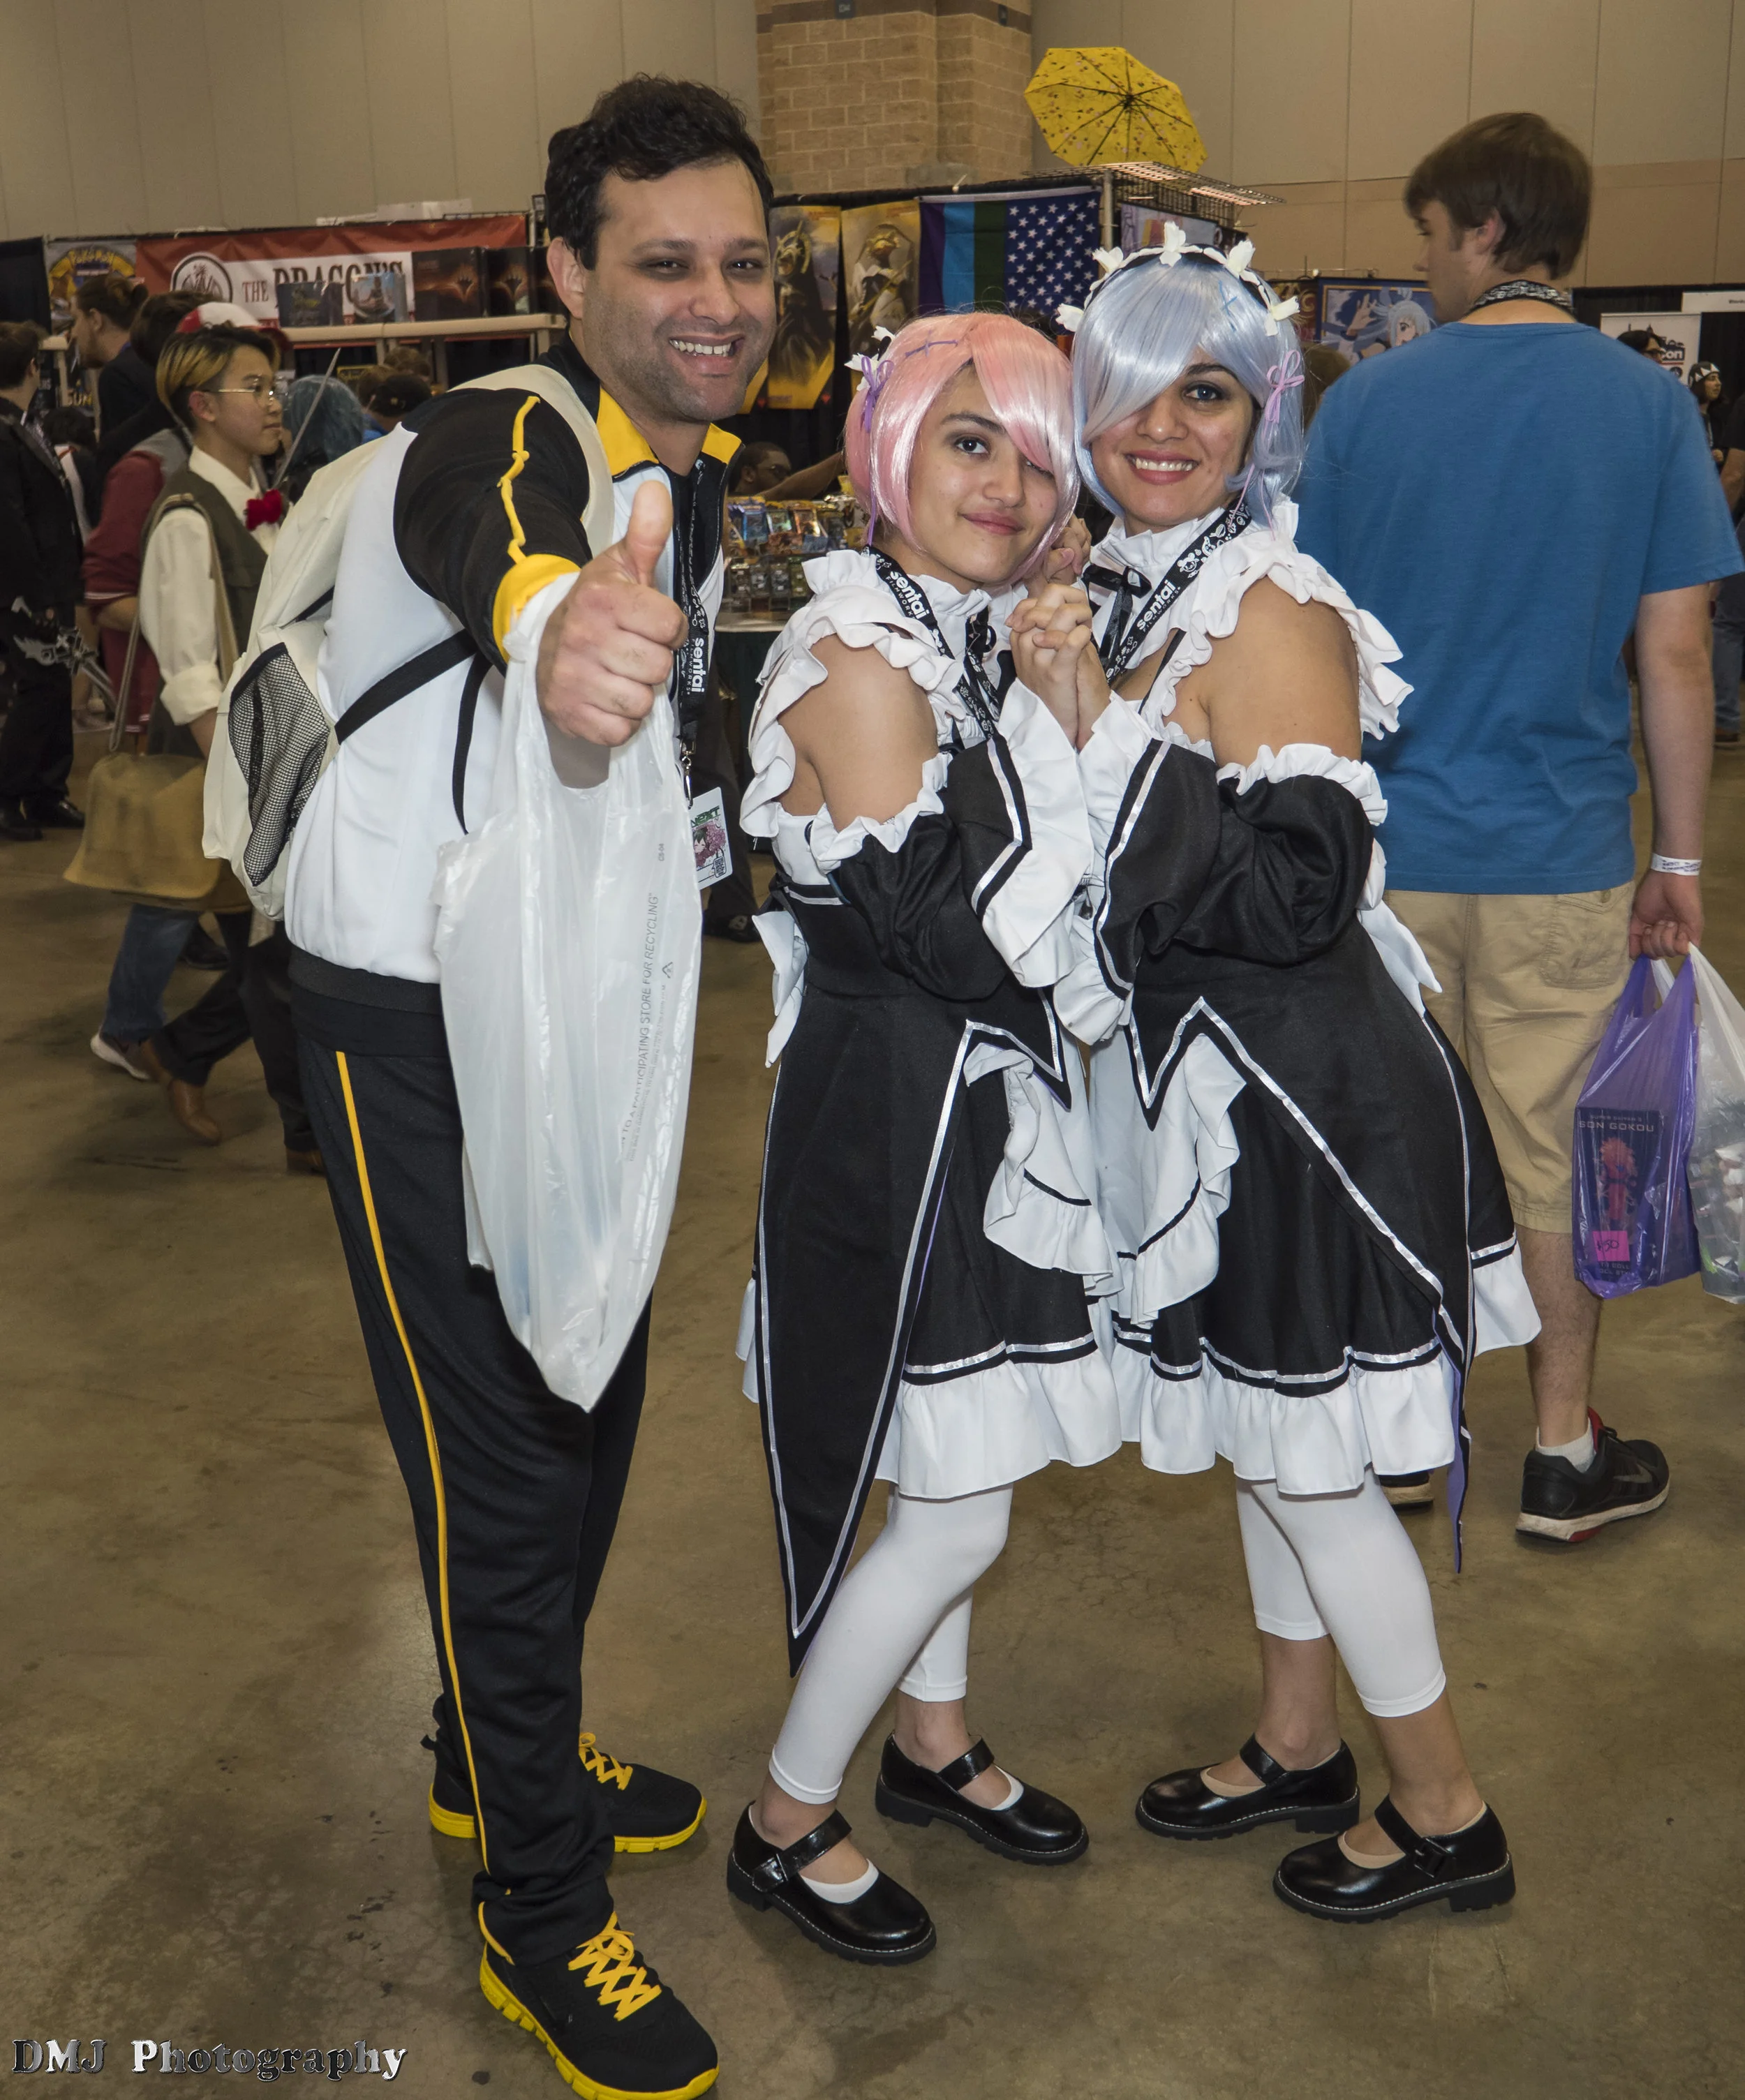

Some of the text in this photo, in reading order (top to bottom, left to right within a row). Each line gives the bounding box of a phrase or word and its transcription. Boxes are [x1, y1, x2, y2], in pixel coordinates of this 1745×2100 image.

[242, 280, 269, 302] THE
[886, 576, 914, 618] FILMWORK
[889, 571, 930, 619] sentai
[1137, 580, 1176, 630] sentai
[691, 637, 706, 692] sentai
[641, 962, 653, 985] FOR
[639, 988, 652, 1024] STORE
[1610, 1122, 1654, 1132] GOKOU
